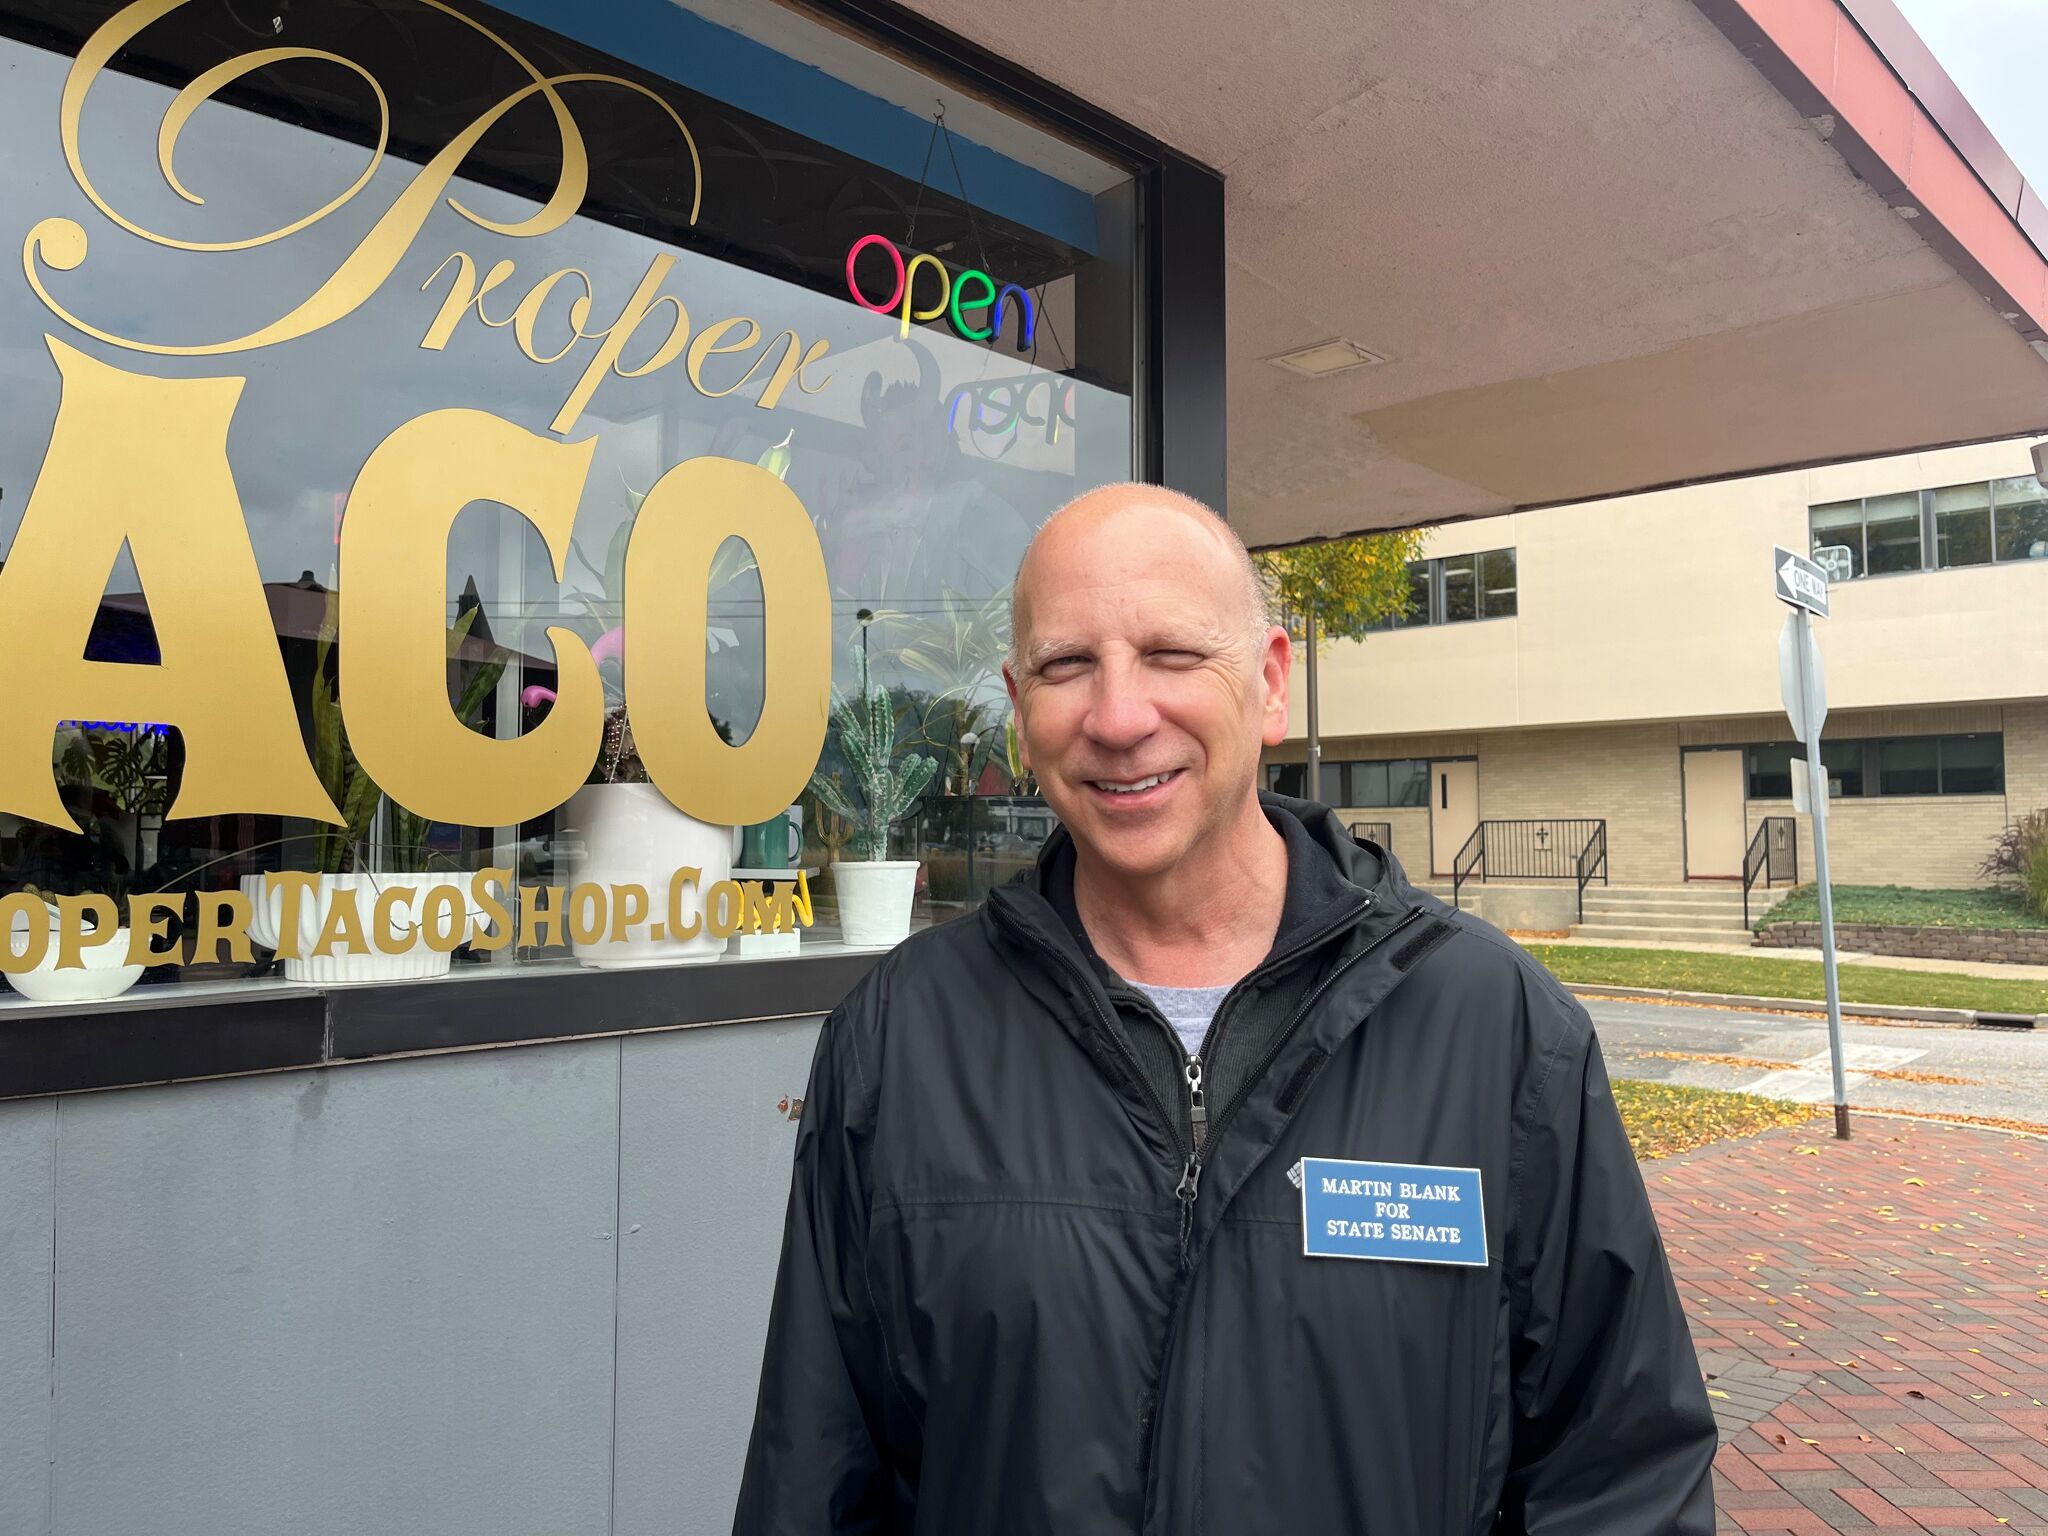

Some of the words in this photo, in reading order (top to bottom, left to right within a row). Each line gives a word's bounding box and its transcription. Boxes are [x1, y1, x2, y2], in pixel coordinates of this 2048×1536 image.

[24, 0, 833, 435] Proper
[1794, 569, 1810, 593] ONE
[1322, 1178, 1392, 1197] MARTIN
[1399, 1183, 1461, 1202] BLANK
[1375, 1202, 1410, 1219] FOR
[1327, 1220, 1385, 1239] STATE
[1391, 1225, 1461, 1244] SENATE
